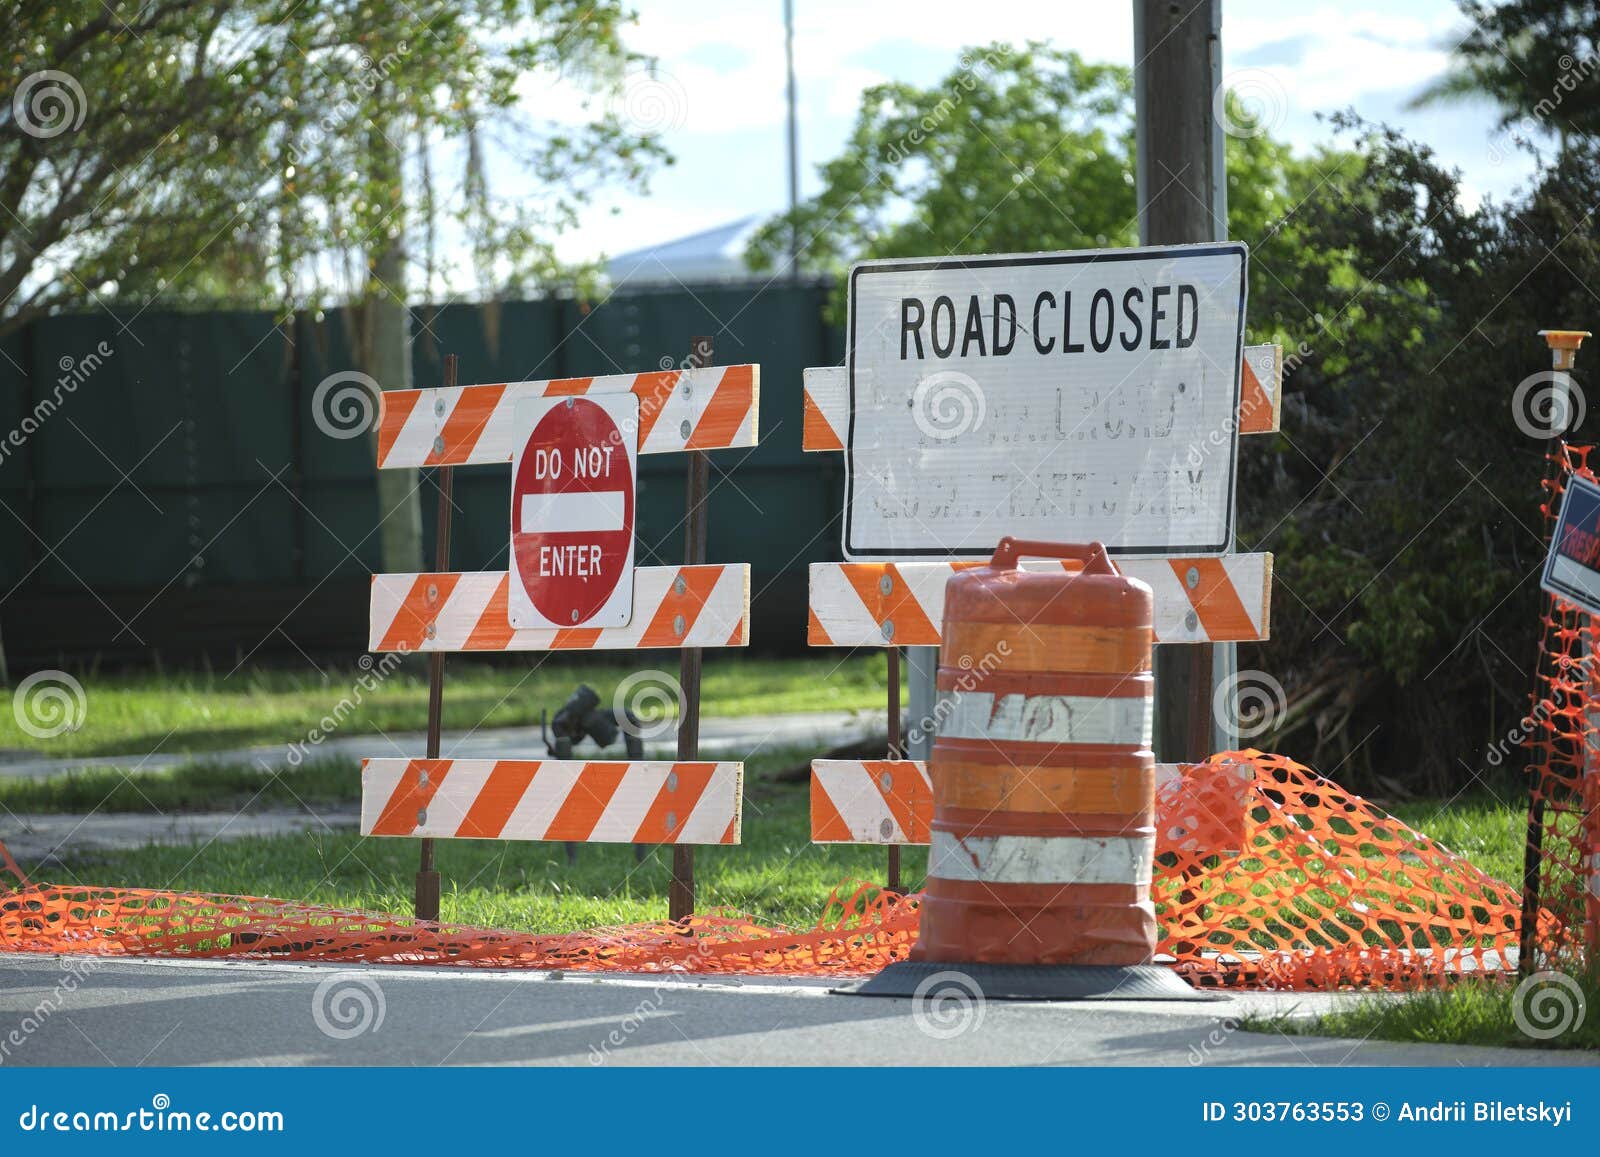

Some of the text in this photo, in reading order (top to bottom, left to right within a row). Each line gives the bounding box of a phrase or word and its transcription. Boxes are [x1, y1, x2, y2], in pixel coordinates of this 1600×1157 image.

[900, 284, 1198, 360] ROAD CLOSED
[535, 446, 614, 480] DO NOT
[539, 545, 602, 577] ENTER
[1561, 522, 1600, 571] TRESP
